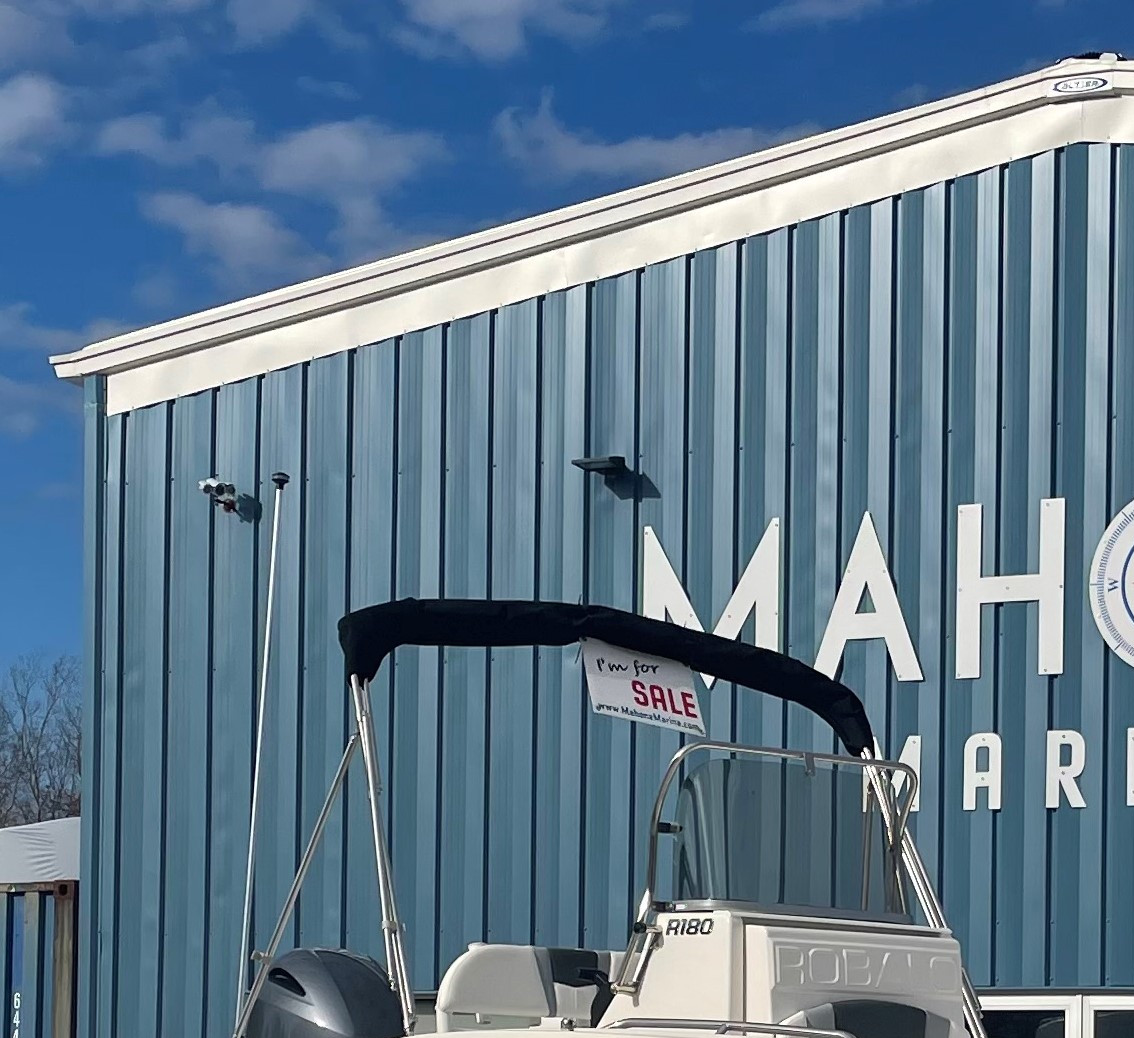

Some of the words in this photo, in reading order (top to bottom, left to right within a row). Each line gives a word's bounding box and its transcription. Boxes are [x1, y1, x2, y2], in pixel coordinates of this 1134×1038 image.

[596, 657, 628, 673] I'm
[633, 659, 660, 677] for
[631, 679, 698, 719] SALE
[666, 919, 714, 935] R180
